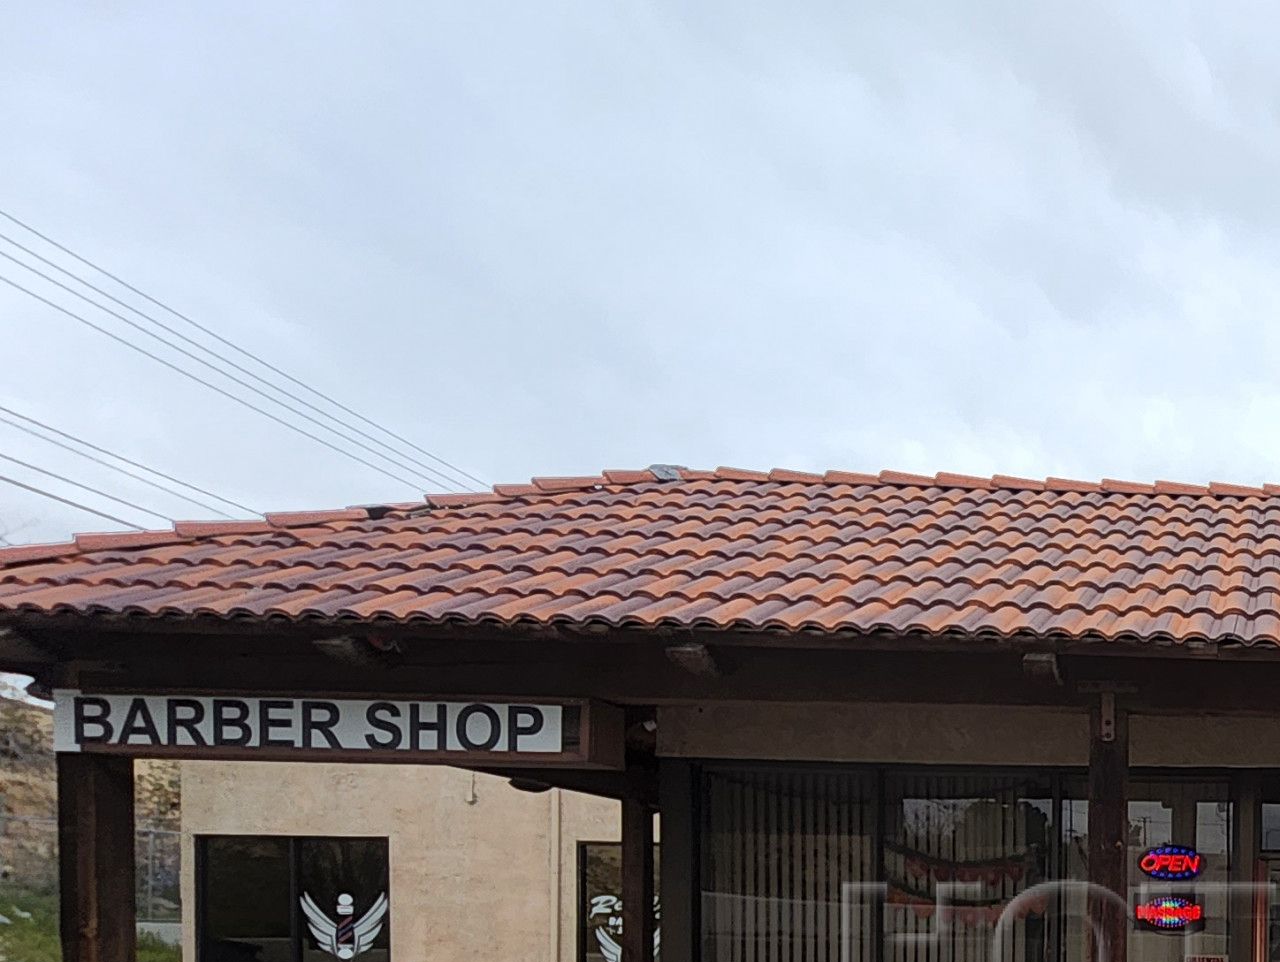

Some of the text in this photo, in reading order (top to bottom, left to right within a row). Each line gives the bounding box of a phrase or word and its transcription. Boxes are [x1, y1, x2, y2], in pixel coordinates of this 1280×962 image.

[74, 696, 545, 753] BARBER SHOP
[1141, 854, 1200, 873] OPEN
[1136, 904, 1201, 920] MASSAGE
